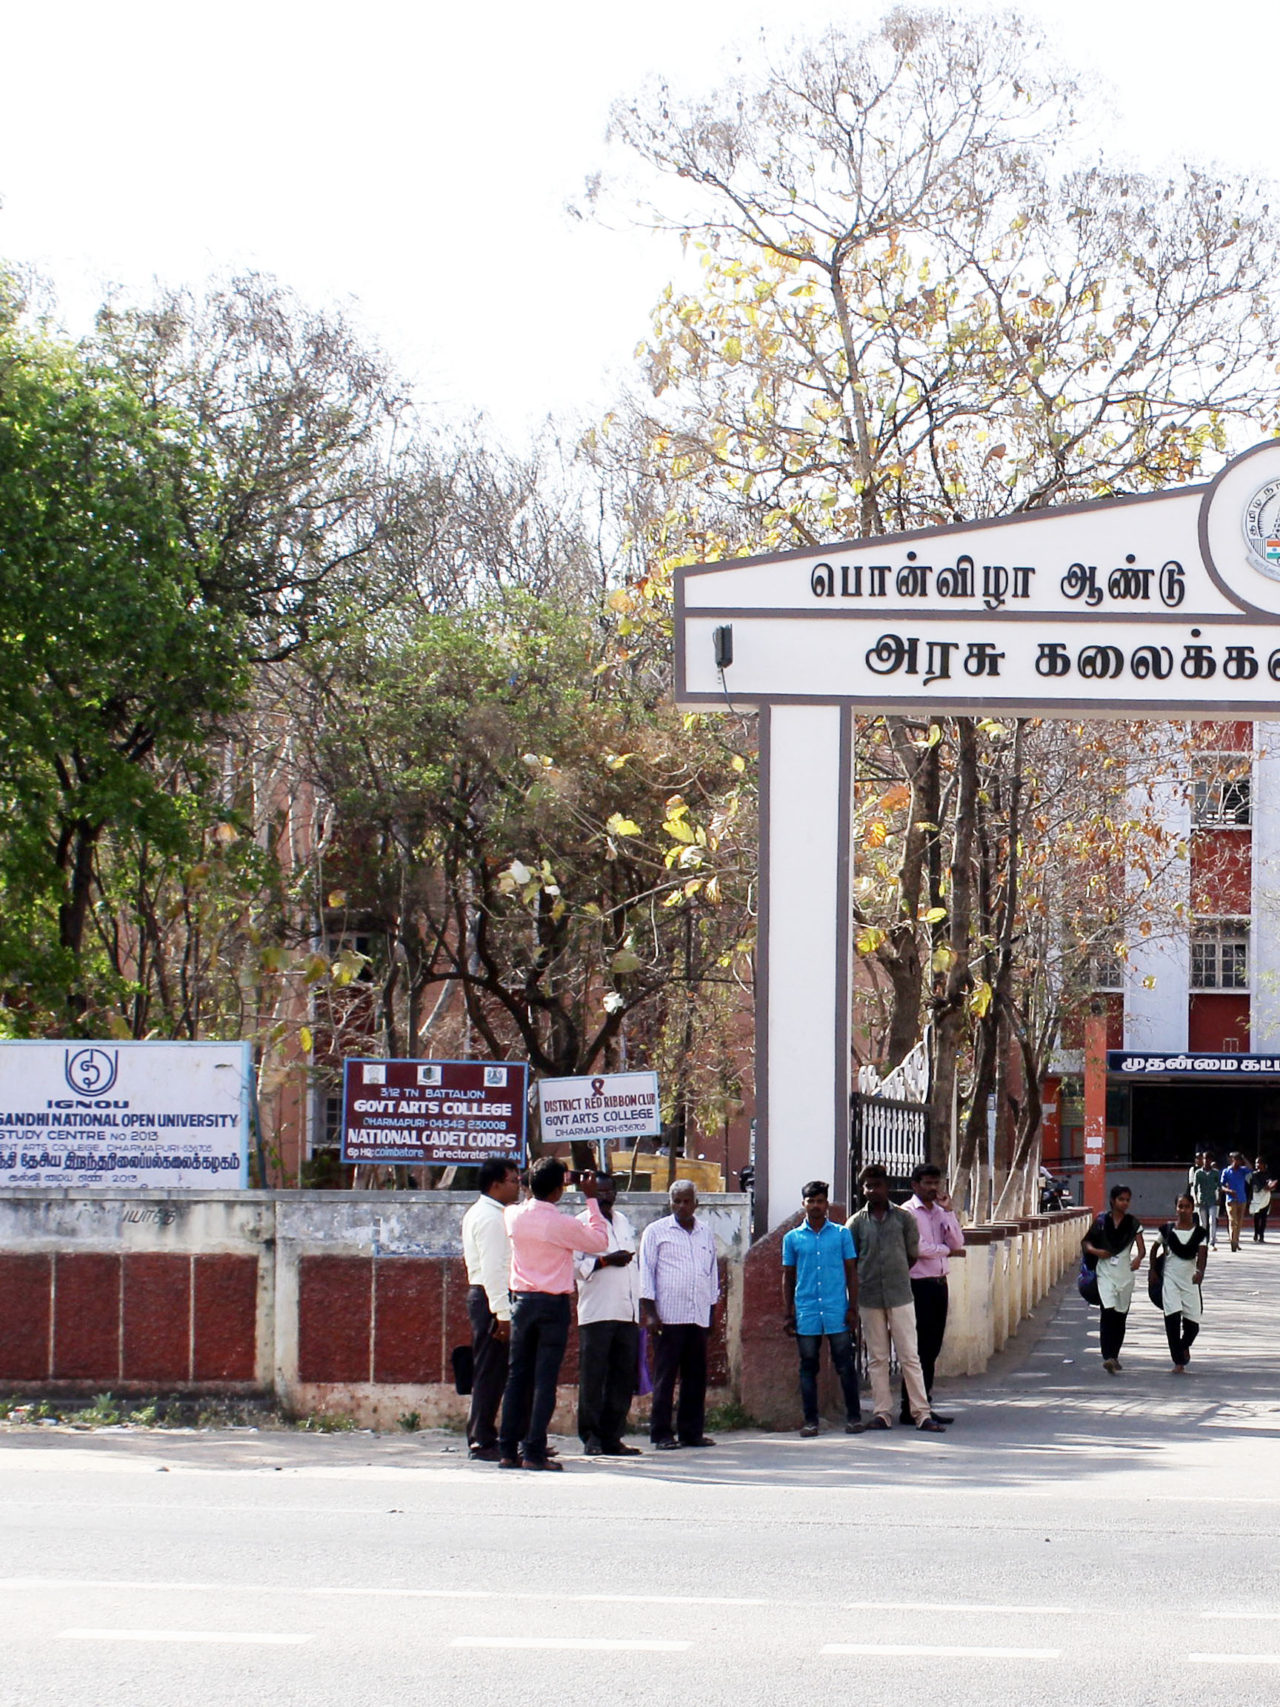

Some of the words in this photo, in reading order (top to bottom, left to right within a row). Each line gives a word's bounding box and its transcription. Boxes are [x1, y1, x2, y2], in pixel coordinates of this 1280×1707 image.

[811, 551, 1036, 611] பொன்விழா
[1060, 554, 1185, 608] ஆண்டு
[865, 634, 1005, 686] அரசு
[1121, 1055, 1238, 1073] முதன்மை
[403, 1088, 420, 1098] TN
[425, 1089, 486, 1099] BATTALION
[47, 1099, 129, 1109] IGNOU
[353, 1099, 396, 1113] GOVT
[398, 1101, 440, 1115] ARTS
[442, 1102, 512, 1116] COLLEGE
[544, 1098, 582, 1113] DISTRICT
[585, 1096, 603, 1110] RED
[604, 1094, 637, 1108] RIBBON
[638, 1092, 656, 1106] CLUB
[51, 1113, 120, 1127] NATIONAL
[121, 1113, 156, 1128] OPEN
[157, 1113, 239, 1128] UNIVERSITY
[545, 1114, 569, 1126] GOVT
[571, 1112, 599, 1124] ARTS
[603, 1109, 654, 1122] COLLEGE
[47, 1130, 106, 1140] CENTRE
[130, 1131, 159, 1142] 2013
[347, 1128, 421, 1145] NATIONAL
[421, 1131, 468, 1147] CADET
[468, 1132, 517, 1148] CORPS
[22, 1144, 48, 1152] ARTS
